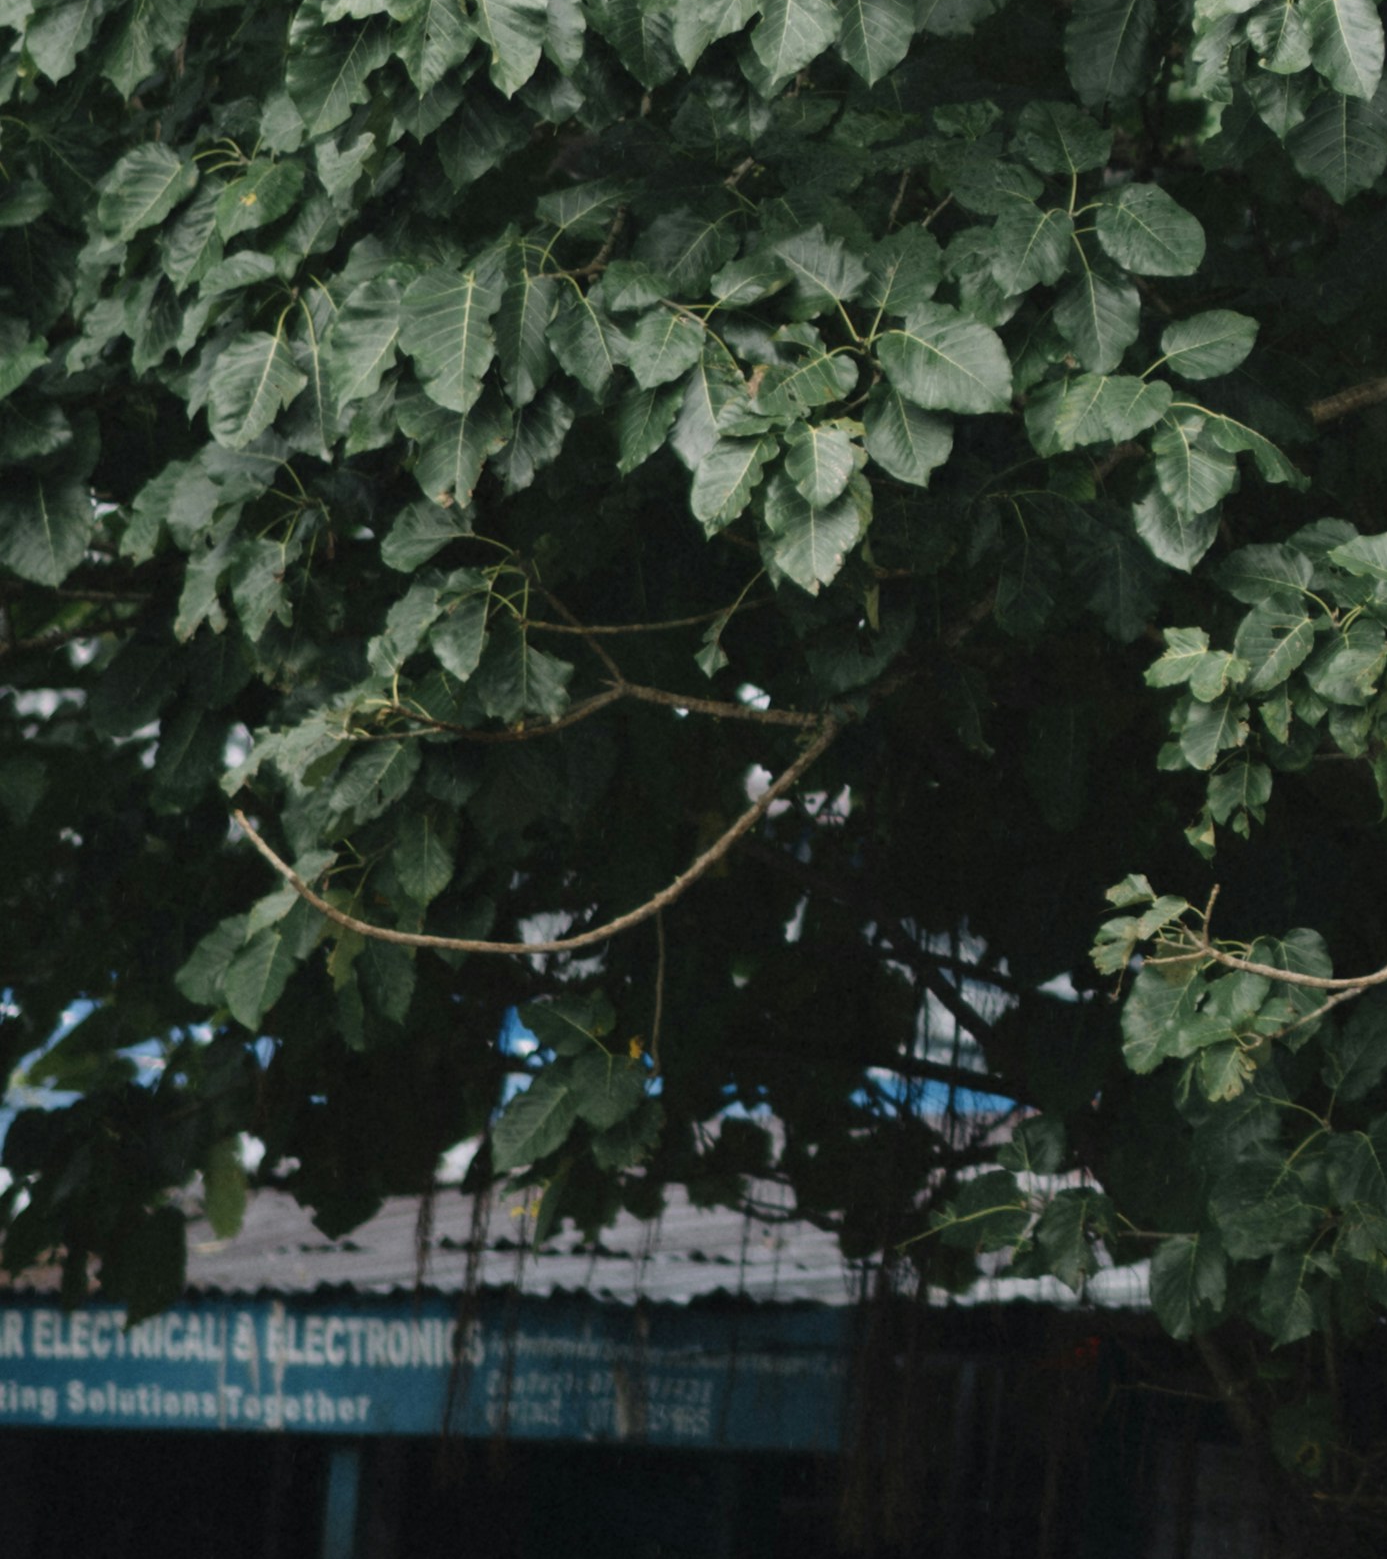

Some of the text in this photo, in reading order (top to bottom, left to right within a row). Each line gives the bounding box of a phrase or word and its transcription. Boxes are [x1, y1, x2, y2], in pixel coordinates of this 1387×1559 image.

[32, 1309, 222, 1362] ELECTRICAL
[266, 1315, 486, 1369] ELECTRONICS
[67, 1380, 218, 1420] Solutions
[219, 1385, 371, 1429] Together
